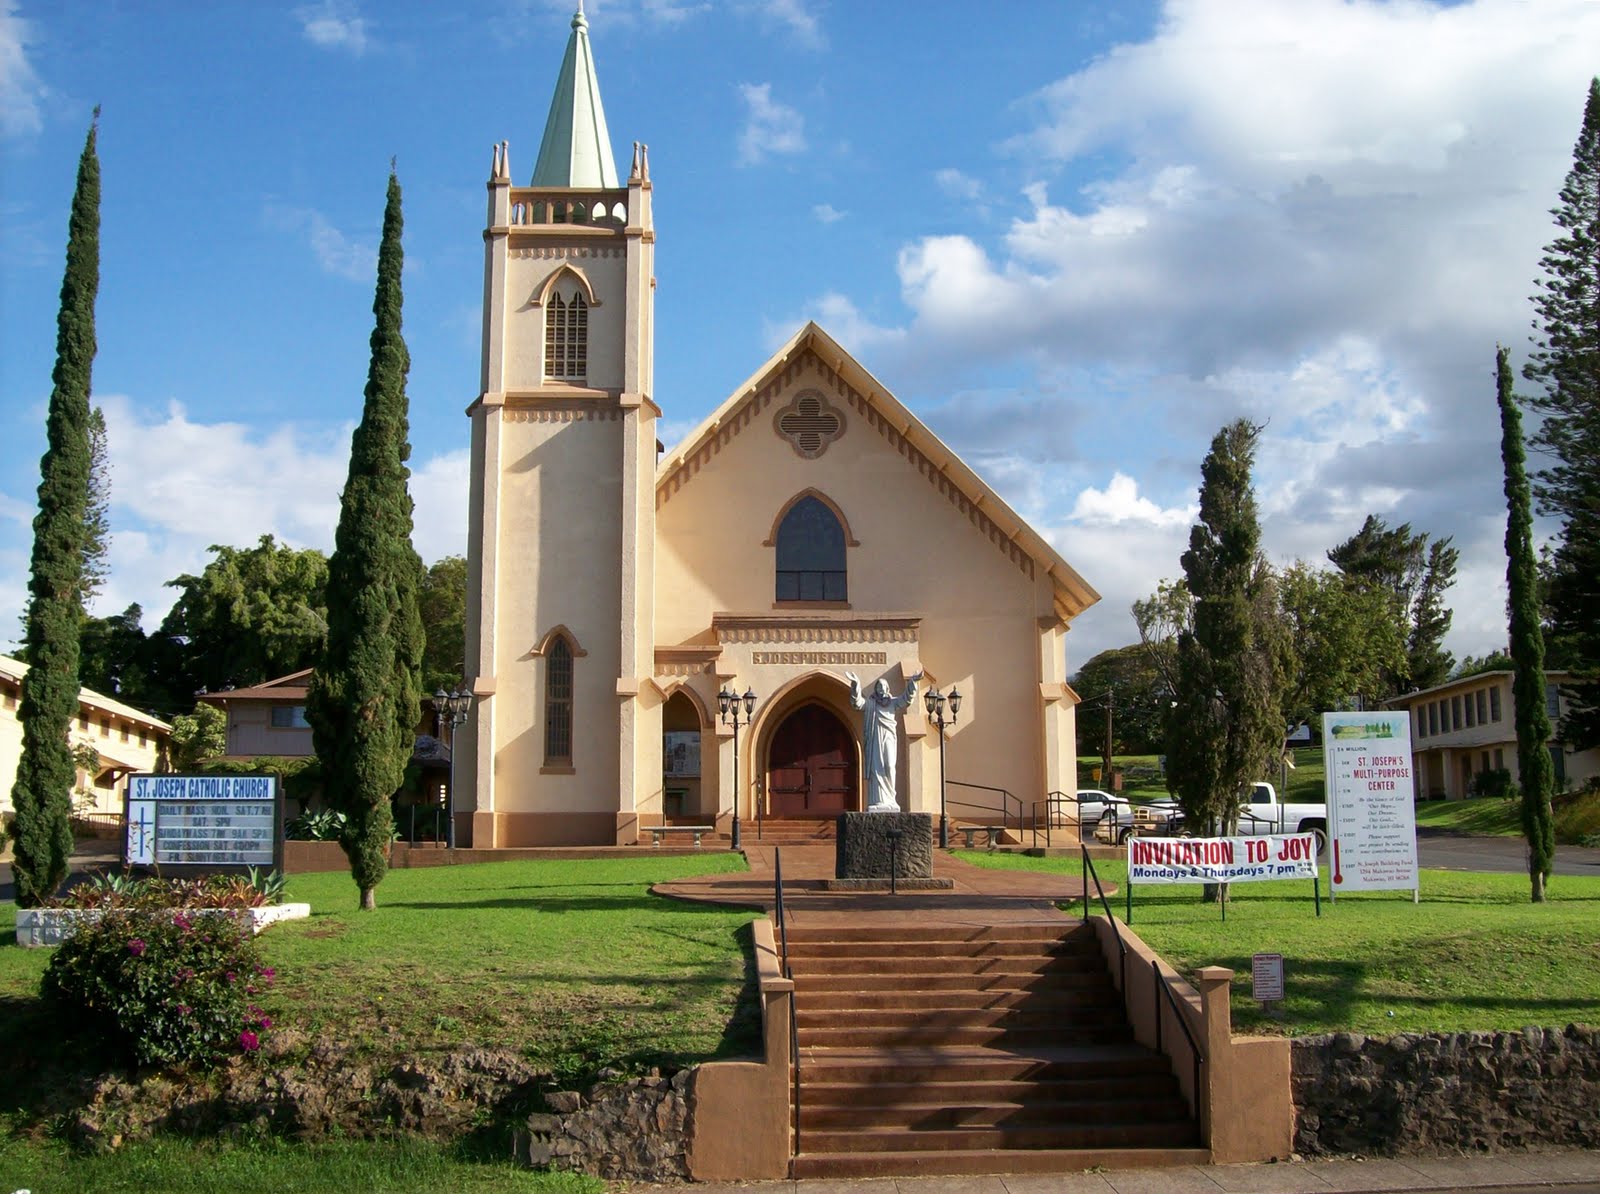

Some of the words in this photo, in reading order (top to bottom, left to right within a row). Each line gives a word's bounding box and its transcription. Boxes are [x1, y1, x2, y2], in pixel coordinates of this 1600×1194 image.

[1371, 756, 1404, 766] JOSEPH'S
[1353, 768, 1409, 779] MULTI-PURPOSE
[136, 778, 150, 797] ST.
[152, 778, 186, 797] JOSEPH
[188, 778, 231, 797] CATHOLIC
[232, 778, 269, 797] CHURCH
[1367, 780, 1396, 791] CENTER
[160, 805, 181, 815] DAILY
[185, 805, 206, 815] MASS
[162, 840, 210, 851] CONFESSION
[1133, 841, 1234, 865] INVITATION
[1244, 840, 1269, 863] TO
[1277, 837, 1313, 861] JOY
[1133, 867, 1188, 879] Mondays
[1190, 867, 1199, 877] &
[1202, 866, 1265, 878] Thursdays
[1266, 864, 1274, 874] 7
[1277, 865, 1296, 876] pm
